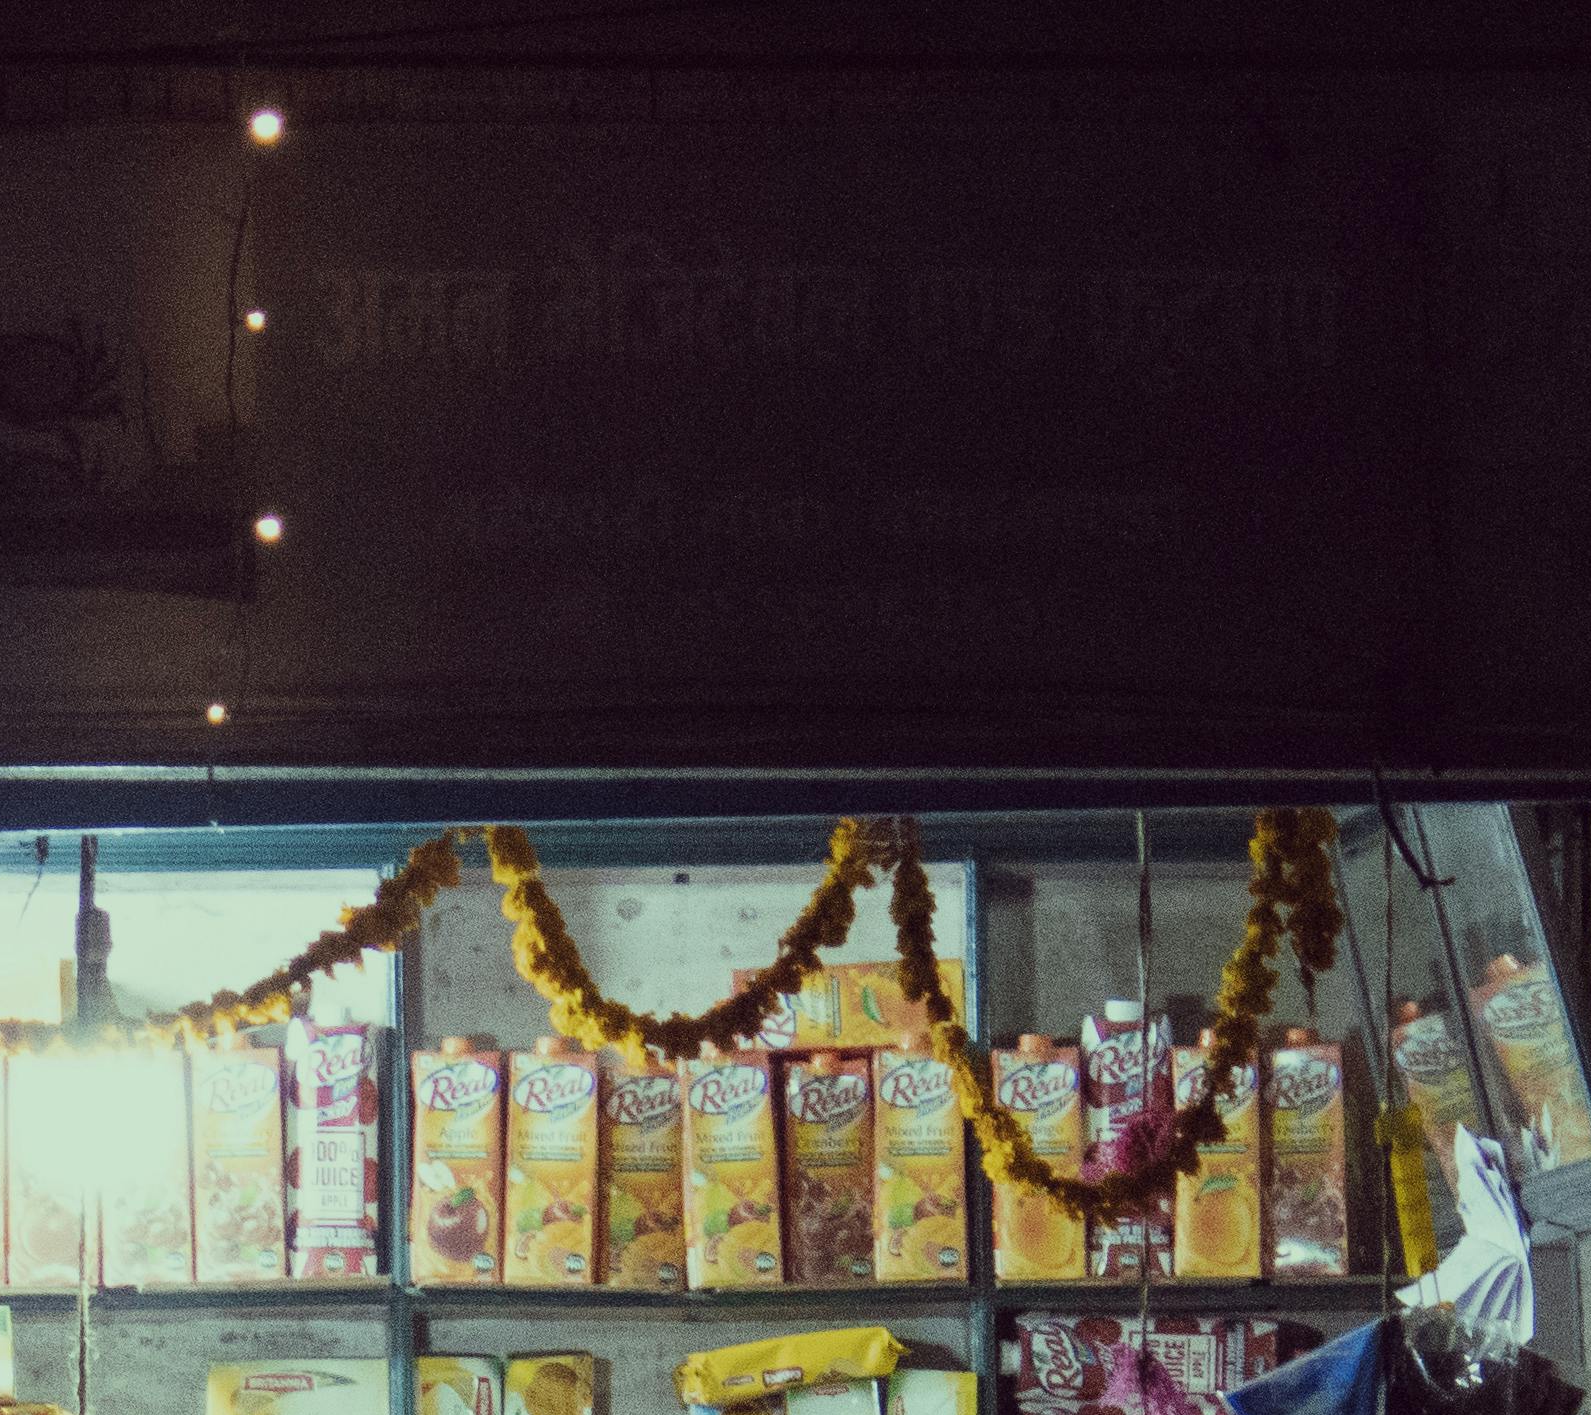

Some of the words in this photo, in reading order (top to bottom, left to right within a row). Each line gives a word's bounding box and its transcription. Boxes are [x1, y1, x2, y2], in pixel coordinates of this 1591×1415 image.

[314, 1049, 368, 1084] Real
[429, 1072, 491, 1112] Real
[523, 1072, 586, 1113] Real
[616, 1087, 680, 1125] Real
[700, 1072, 761, 1112] Real
[801, 1083, 862, 1122] Real
[892, 1071, 953, 1107] Real
[1009, 1070, 1068, 1110] Real
[439, 1127, 477, 1143] Apple
[1038, 1327, 1082, 1390] Real
[248, 1376, 311, 1391] BRITANNIA
